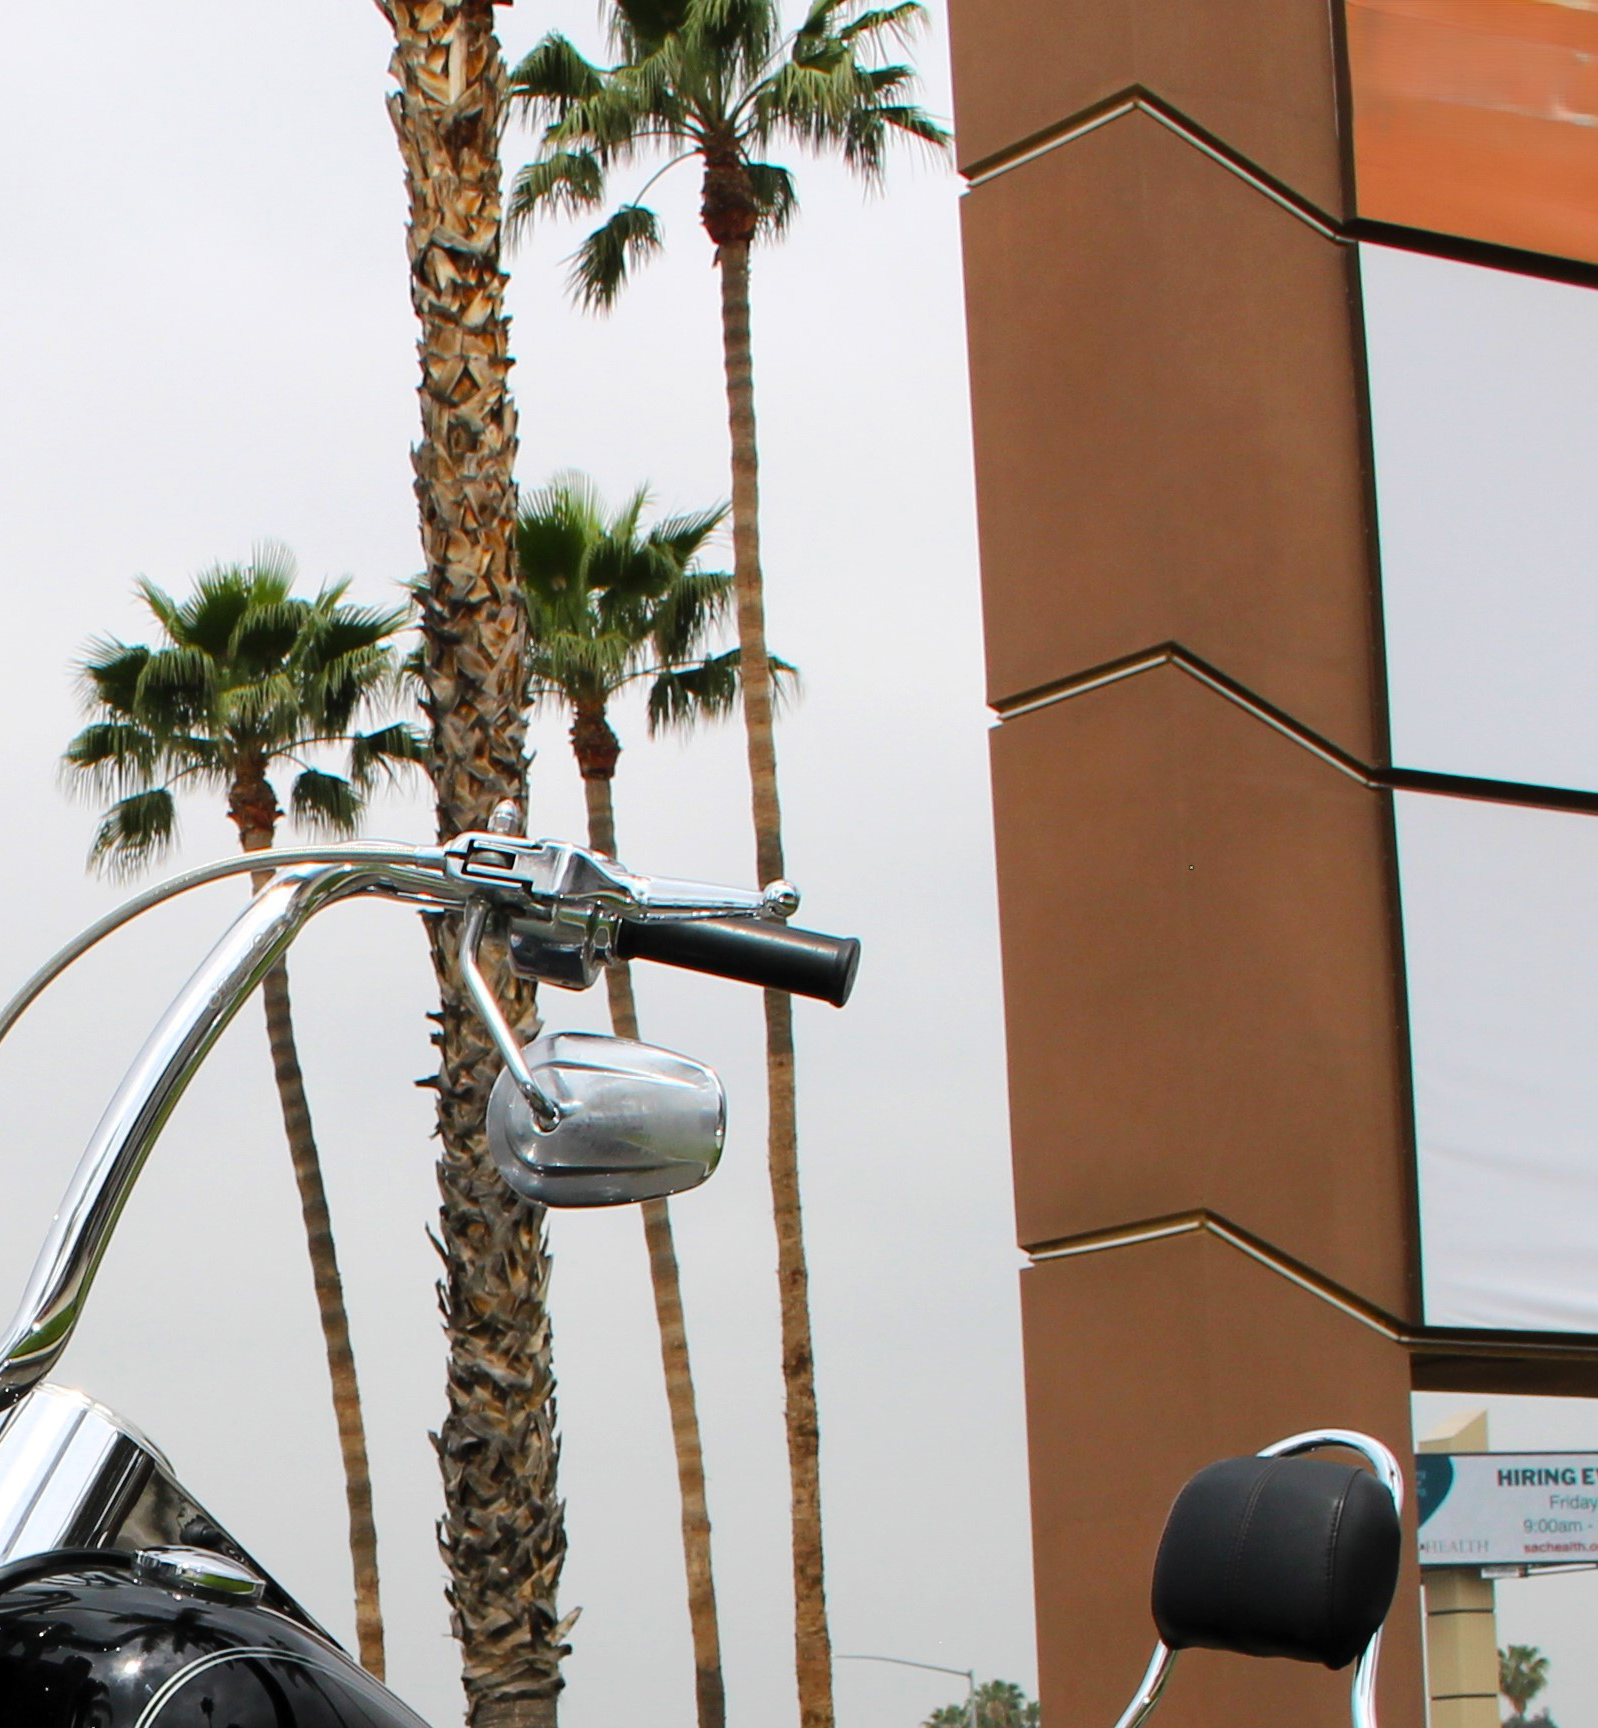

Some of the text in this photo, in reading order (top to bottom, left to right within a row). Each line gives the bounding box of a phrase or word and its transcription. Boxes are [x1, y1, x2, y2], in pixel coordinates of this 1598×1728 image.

[1498, 1468, 1598, 1487] HIRING E
[1549, 1495, 1598, 1513] Friday
